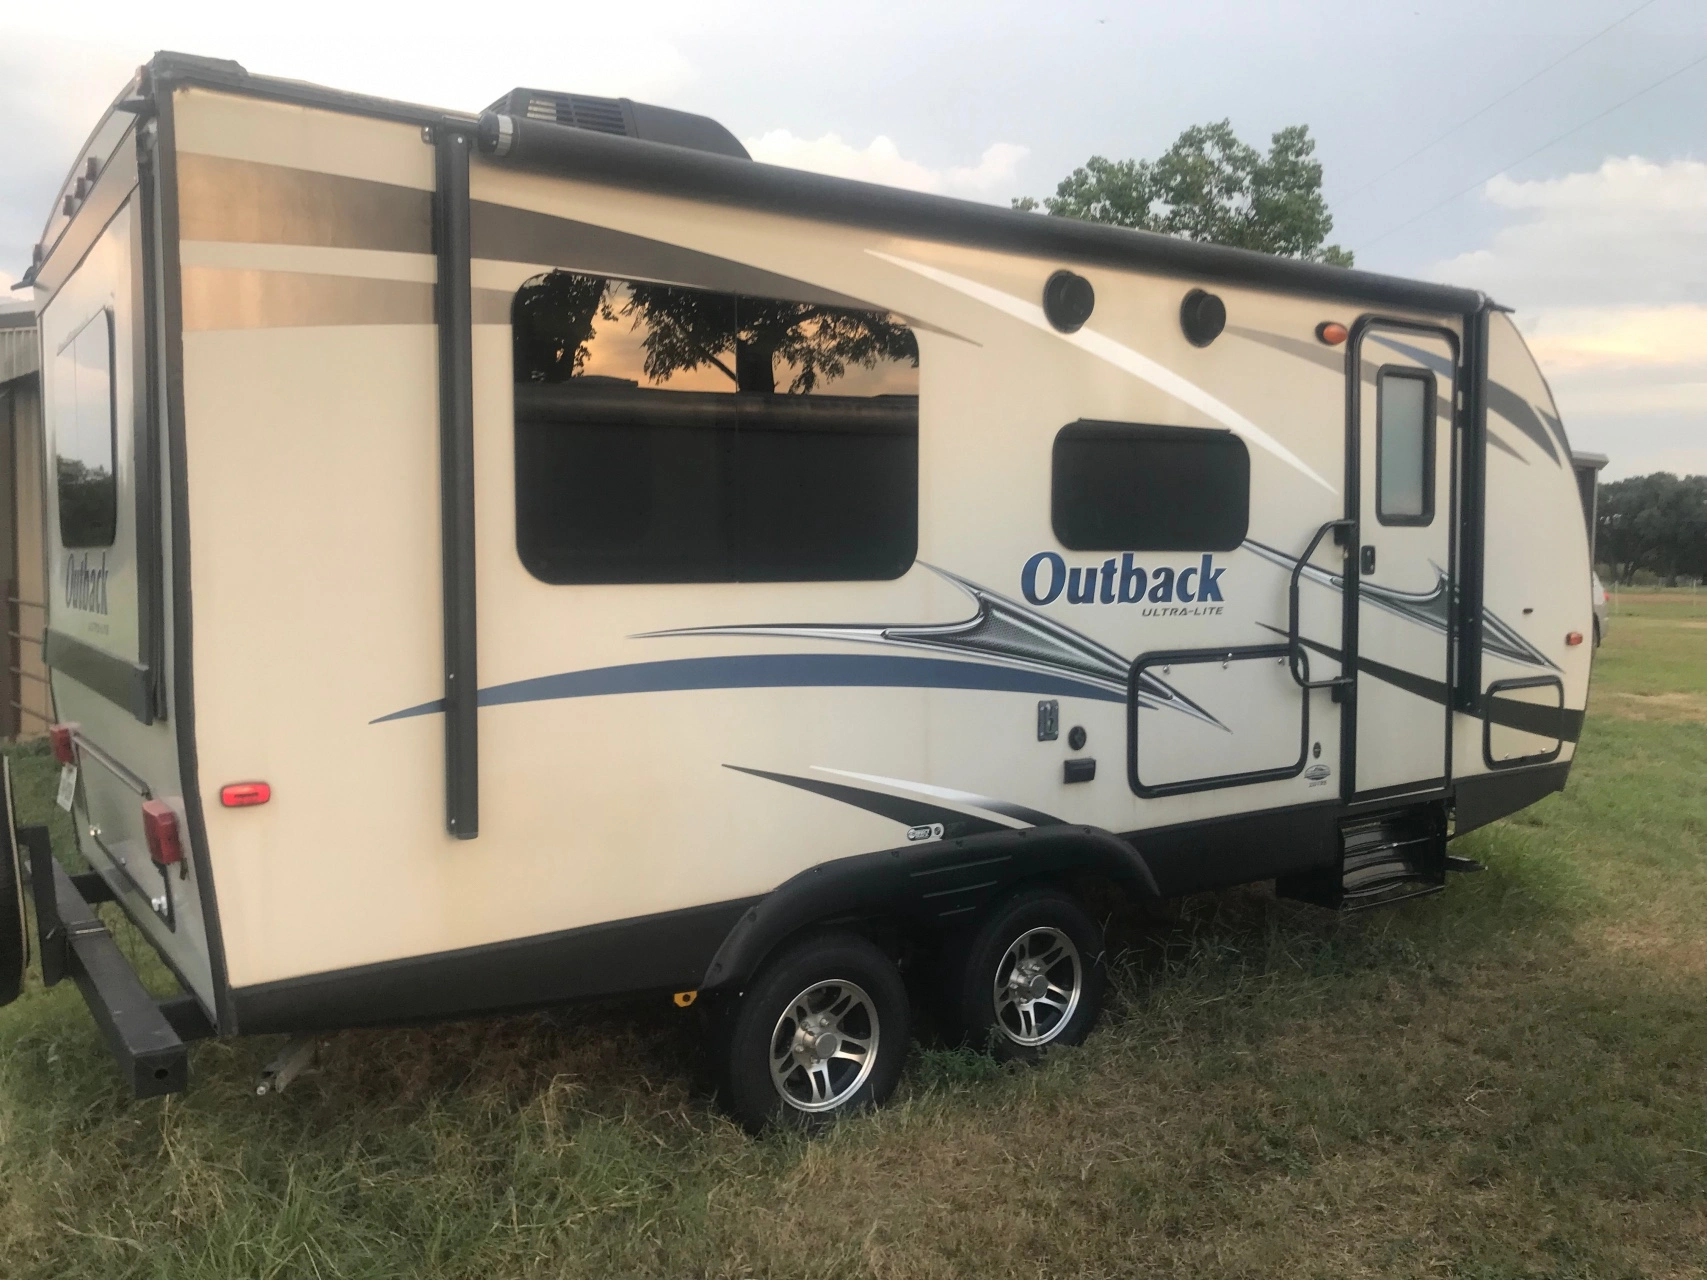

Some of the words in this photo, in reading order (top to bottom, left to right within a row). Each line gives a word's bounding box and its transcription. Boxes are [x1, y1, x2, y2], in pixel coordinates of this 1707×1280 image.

[65, 551, 109, 616] Outback
[1021, 551, 1227, 606] Outback
[1141, 606, 1224, 617] ULTRA-LITE
